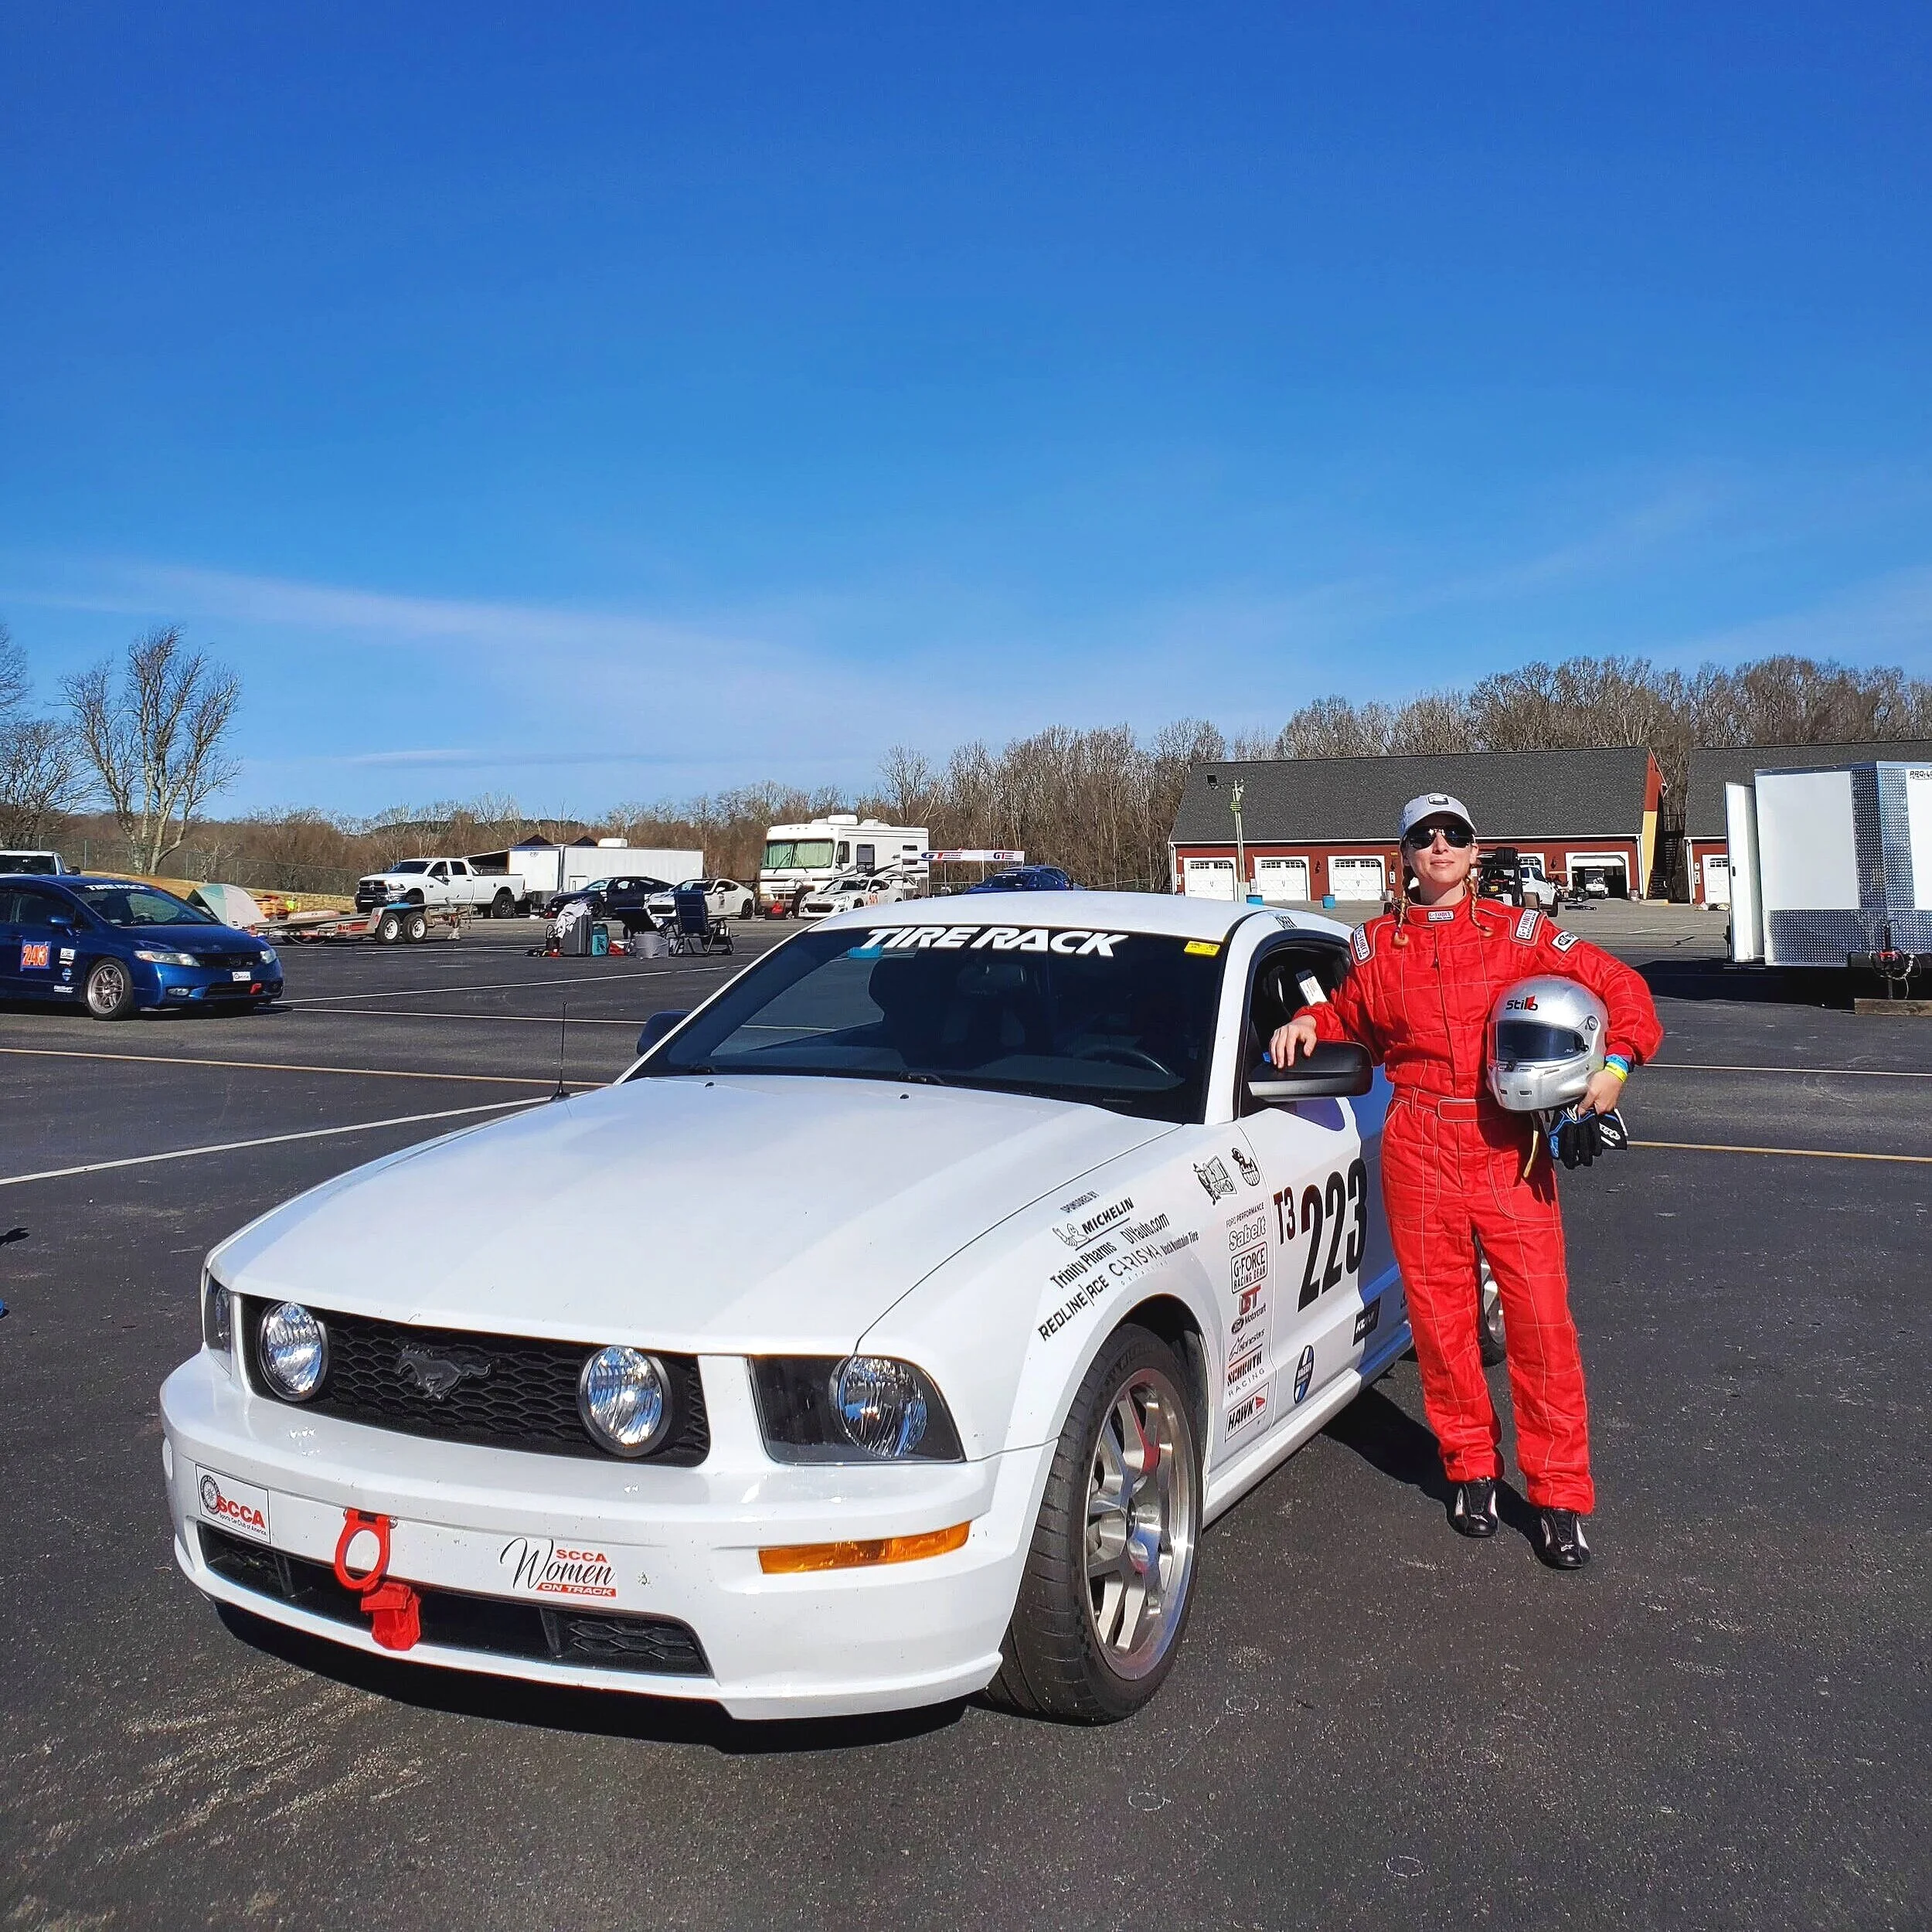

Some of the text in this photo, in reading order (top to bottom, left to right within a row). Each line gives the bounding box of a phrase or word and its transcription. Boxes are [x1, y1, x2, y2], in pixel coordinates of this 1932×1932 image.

[22, 944, 48, 966] 243
[860, 927, 1129, 957] TIRE RACK
[1505, 995, 1538, 1011] Stilo
[1082, 1197, 1134, 1234] MICHELIN
[1120, 1213, 1170, 1244] DIYauto.com
[1229, 1216, 1266, 1251] Sabelt
[1274, 1158, 1367, 1312] T3 223
[1049, 1241, 1117, 1288] Trinity Pharms
[1233, 1272, 1252, 1290] RACING
[1228, 1368, 1265, 1397] RACING
[1227, 1398, 1255, 1432] HAWK
[217, 1495, 266, 1529] SCCA
[500, 1537, 615, 1590] Women
[556, 1549, 608, 1563] SCCA
[566, 1586, 613, 1596] TRACK
